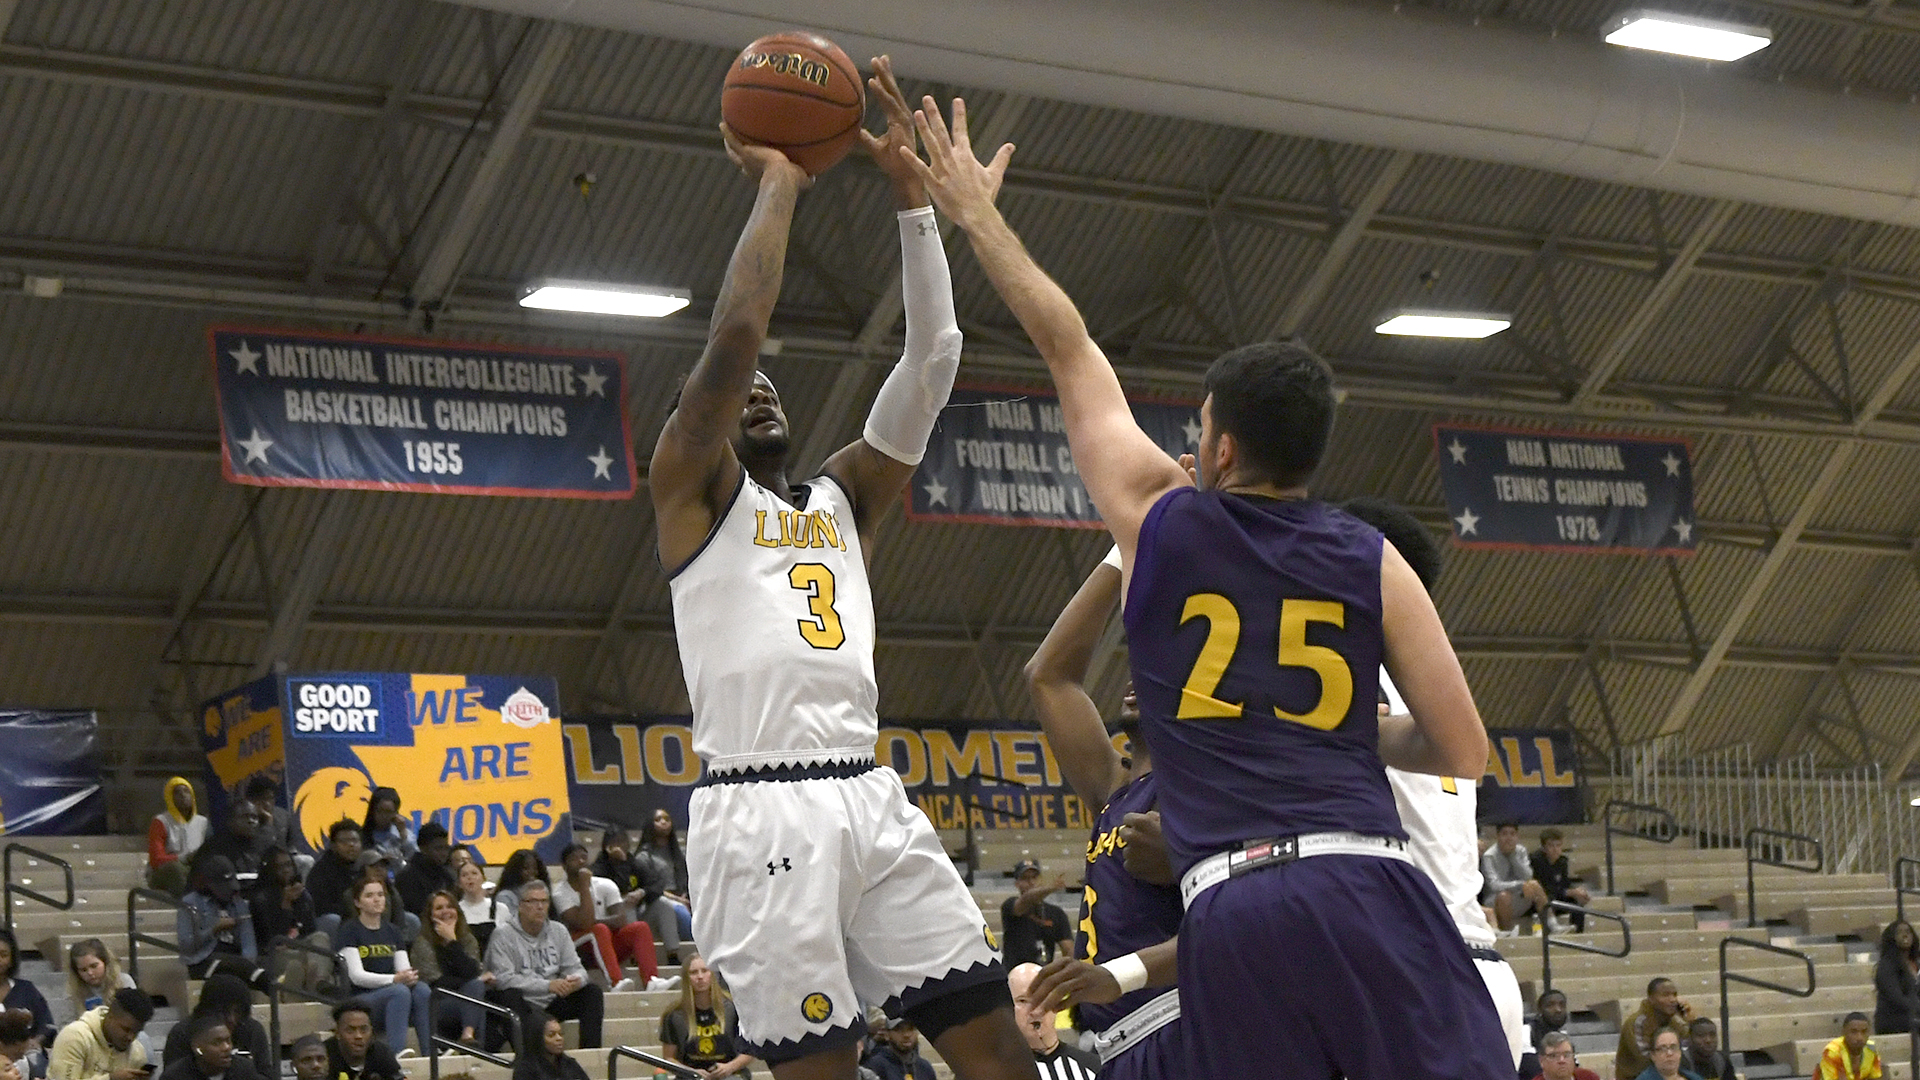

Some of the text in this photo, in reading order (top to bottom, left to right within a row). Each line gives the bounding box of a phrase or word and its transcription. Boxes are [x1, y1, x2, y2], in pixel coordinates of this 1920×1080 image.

[266, 344, 576, 396] NATIONAL INTERCOLLEGIATE
[285, 389, 567, 437] BASKETBALL CHAMPIONS
[986, 402, 1034, 431] NAIA
[403, 441, 464, 475] 1955
[955, 439, 1051, 474] FOOTBALL
[1506, 440, 1625, 471] NAIA NATIONAL
[980, 481, 1066, 514] DIVISION
[1494, 475, 1648, 507] TENNIS CHAMPIONS
[754, 510, 847, 552] LION
[1556, 515, 1600, 541] 1978
[788, 562, 846, 650] 3
[1176, 593, 1353, 731] 25
[300, 684, 371, 709] GOOD
[407, 687, 483, 726] WE
[295, 707, 379, 732] SPORT
[439, 742, 531, 782] ARE
[563, 724, 702, 786] LIO
[1476, 737, 1575, 787] ALL
[918, 794, 987, 829] NCAA
[992, 794, 1057, 829] ELITE
